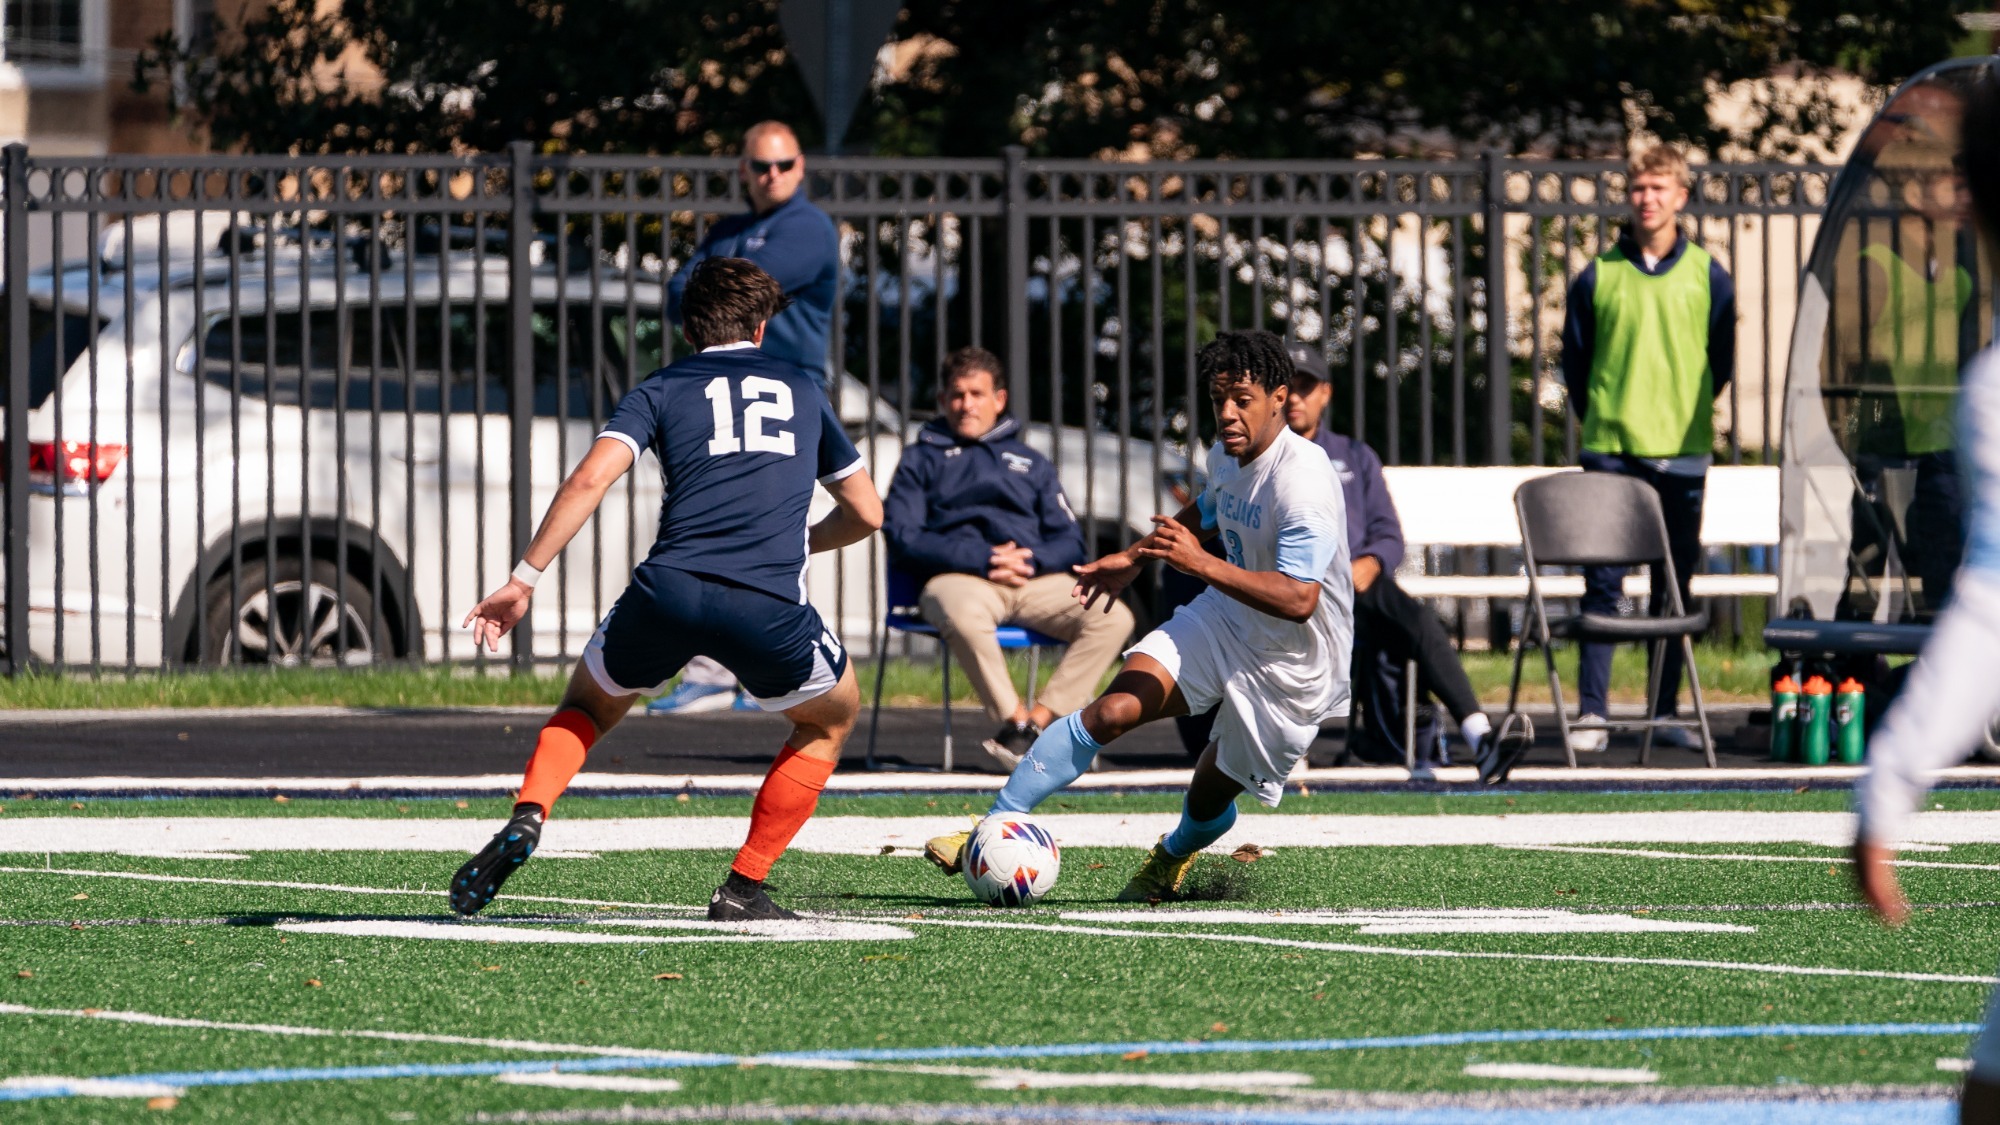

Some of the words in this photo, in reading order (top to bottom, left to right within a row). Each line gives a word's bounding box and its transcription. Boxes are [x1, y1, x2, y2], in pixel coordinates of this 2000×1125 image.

[704, 375, 796, 456] 12
[1220, 489, 1262, 530] UEJAYS
[1225, 529, 1246, 570] 3
